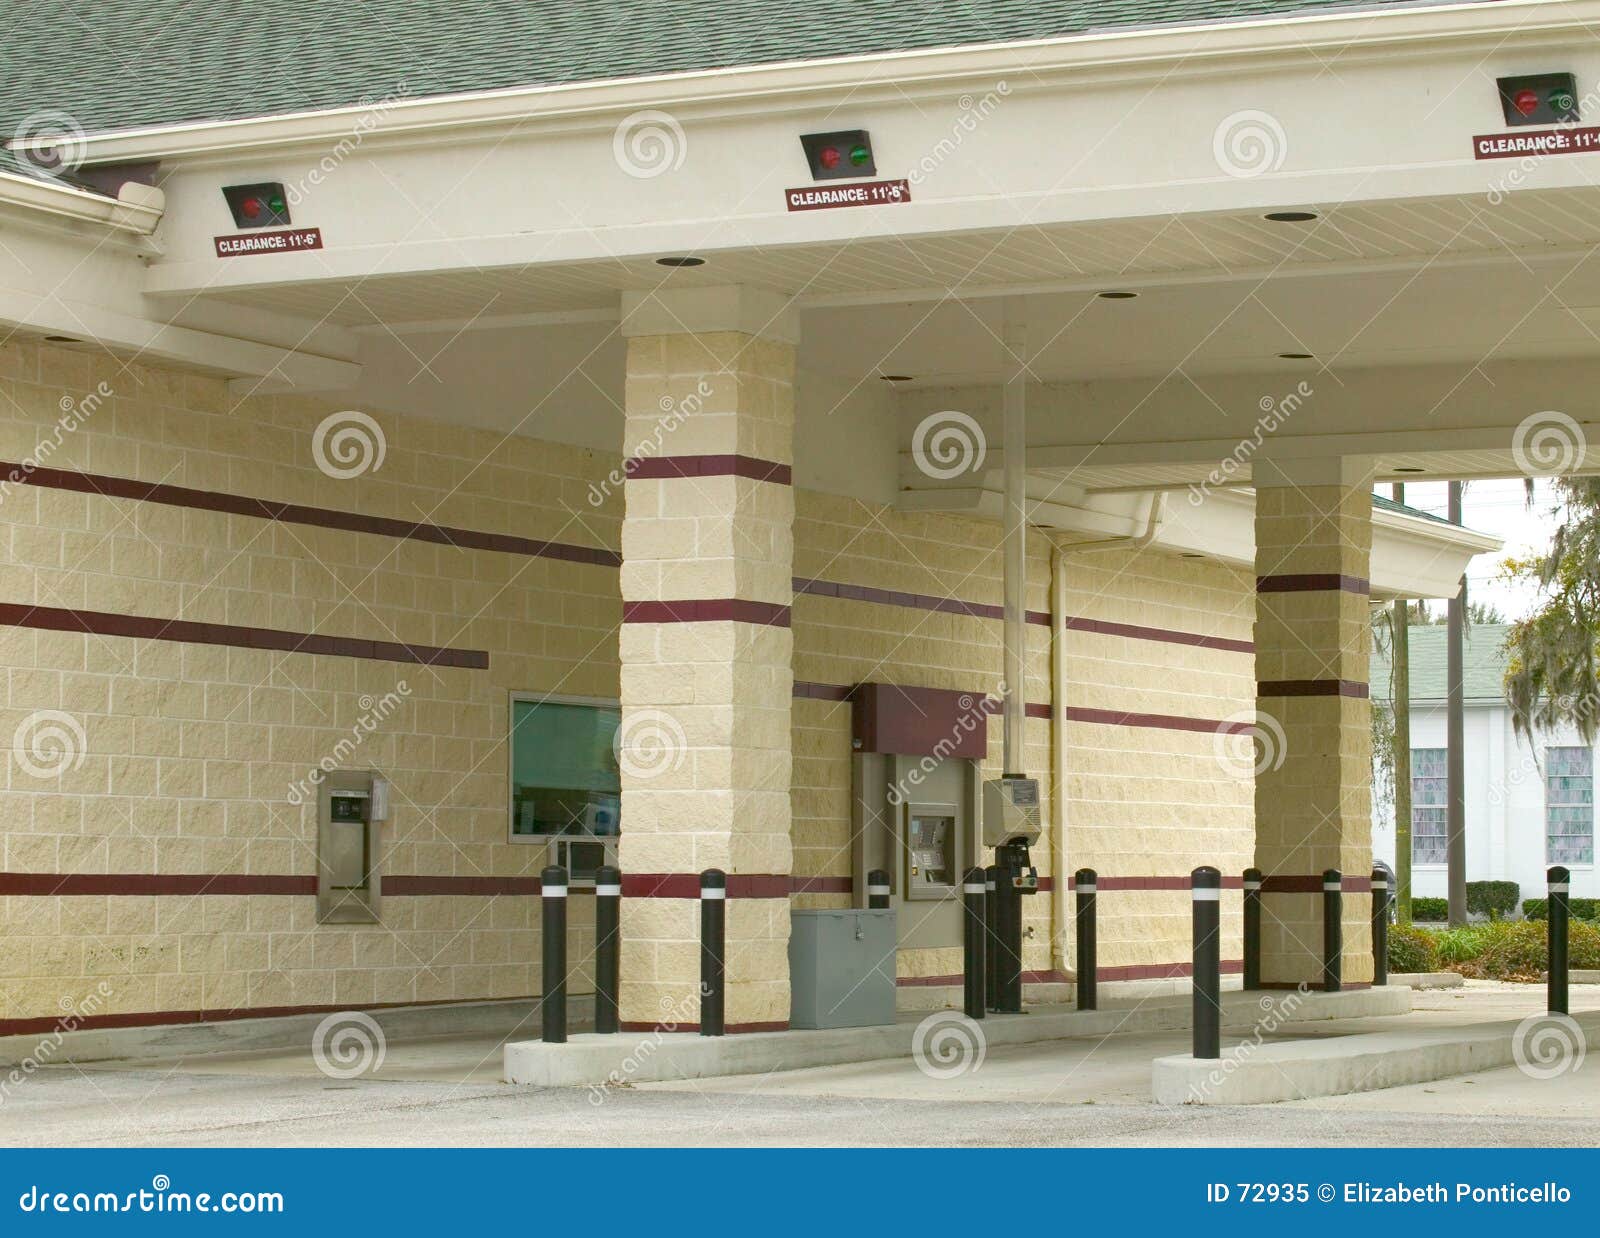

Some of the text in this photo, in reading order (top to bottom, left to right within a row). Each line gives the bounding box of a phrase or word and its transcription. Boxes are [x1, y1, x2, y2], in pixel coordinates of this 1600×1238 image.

[1479, 134, 1570, 154] CLEARANCE:
[790, 185, 904, 206] CLEARANCE: 11'-6"
[219, 233, 317, 253] CLEARANCE: 11'-6"
